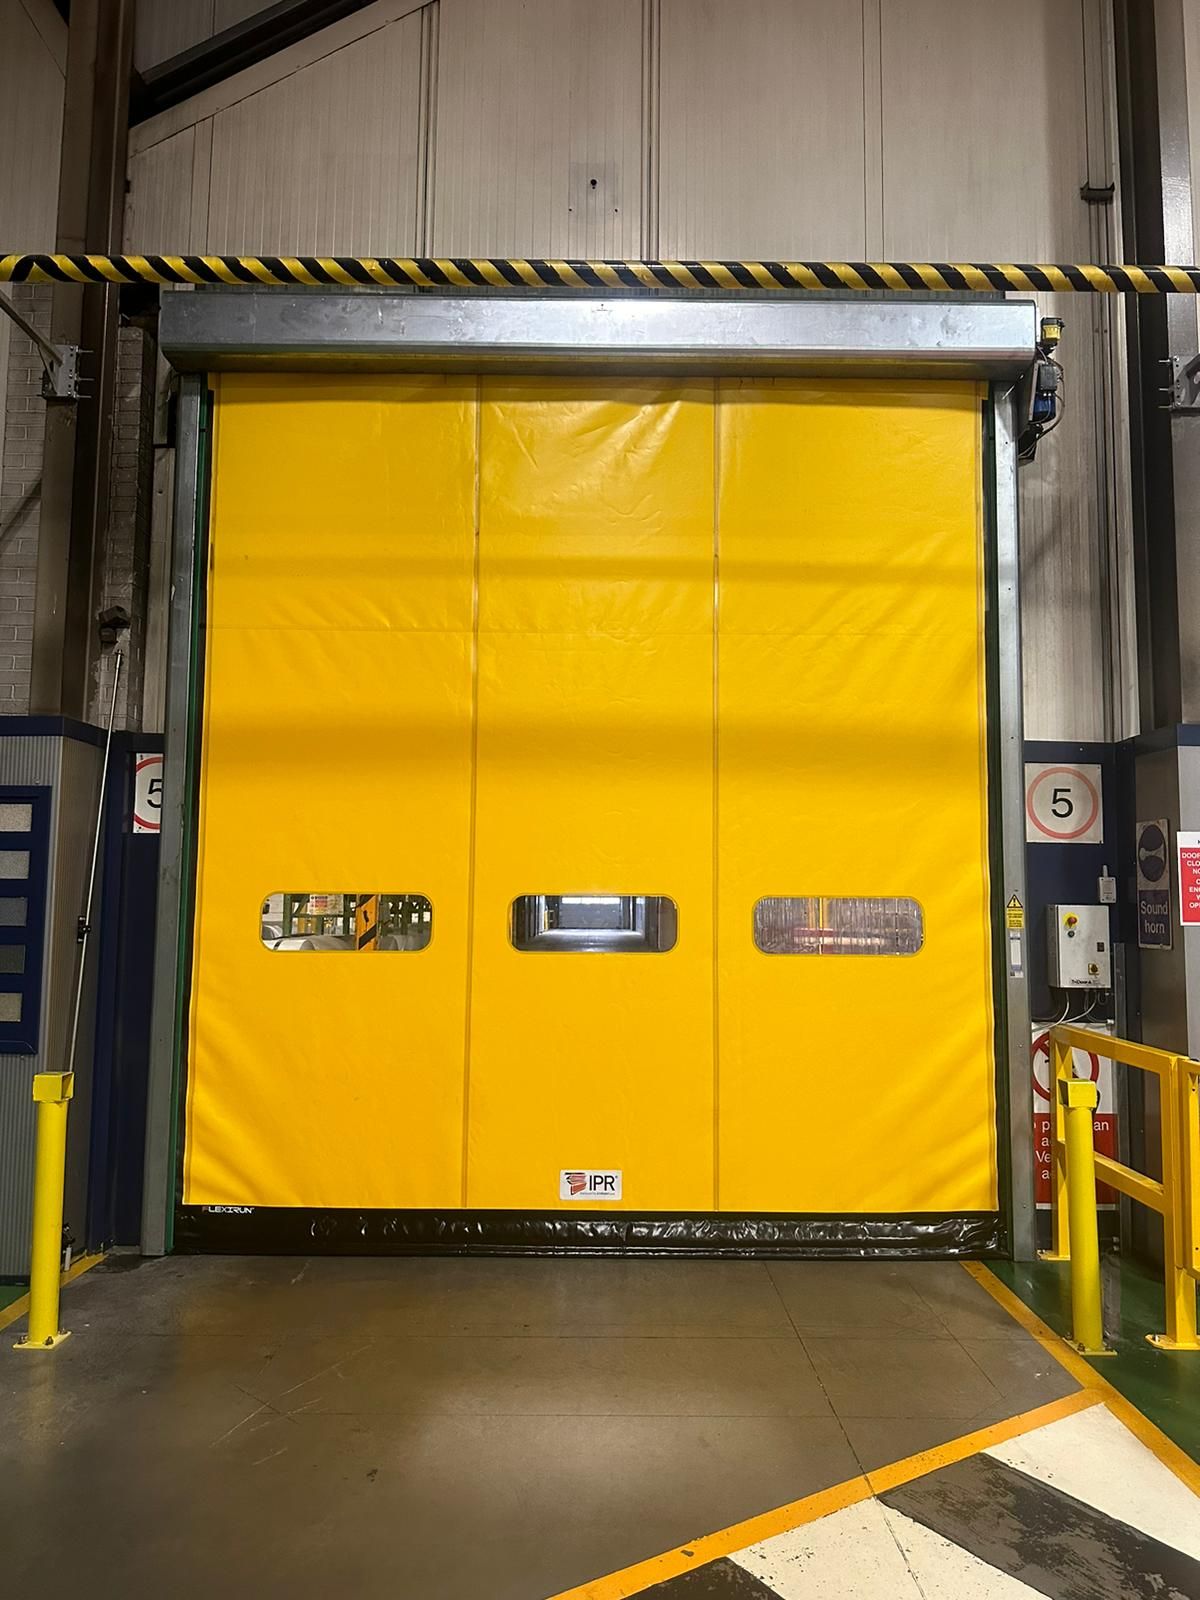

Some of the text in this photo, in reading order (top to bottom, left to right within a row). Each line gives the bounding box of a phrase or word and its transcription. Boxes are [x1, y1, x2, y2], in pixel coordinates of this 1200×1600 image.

[147, 778, 163, 808] 5
[1050, 788, 1074, 818] 5
[1140, 900, 1168, 915] Sound
[1144, 919, 1165, 934] horn
[589, 1175, 616, 1191] IPR
